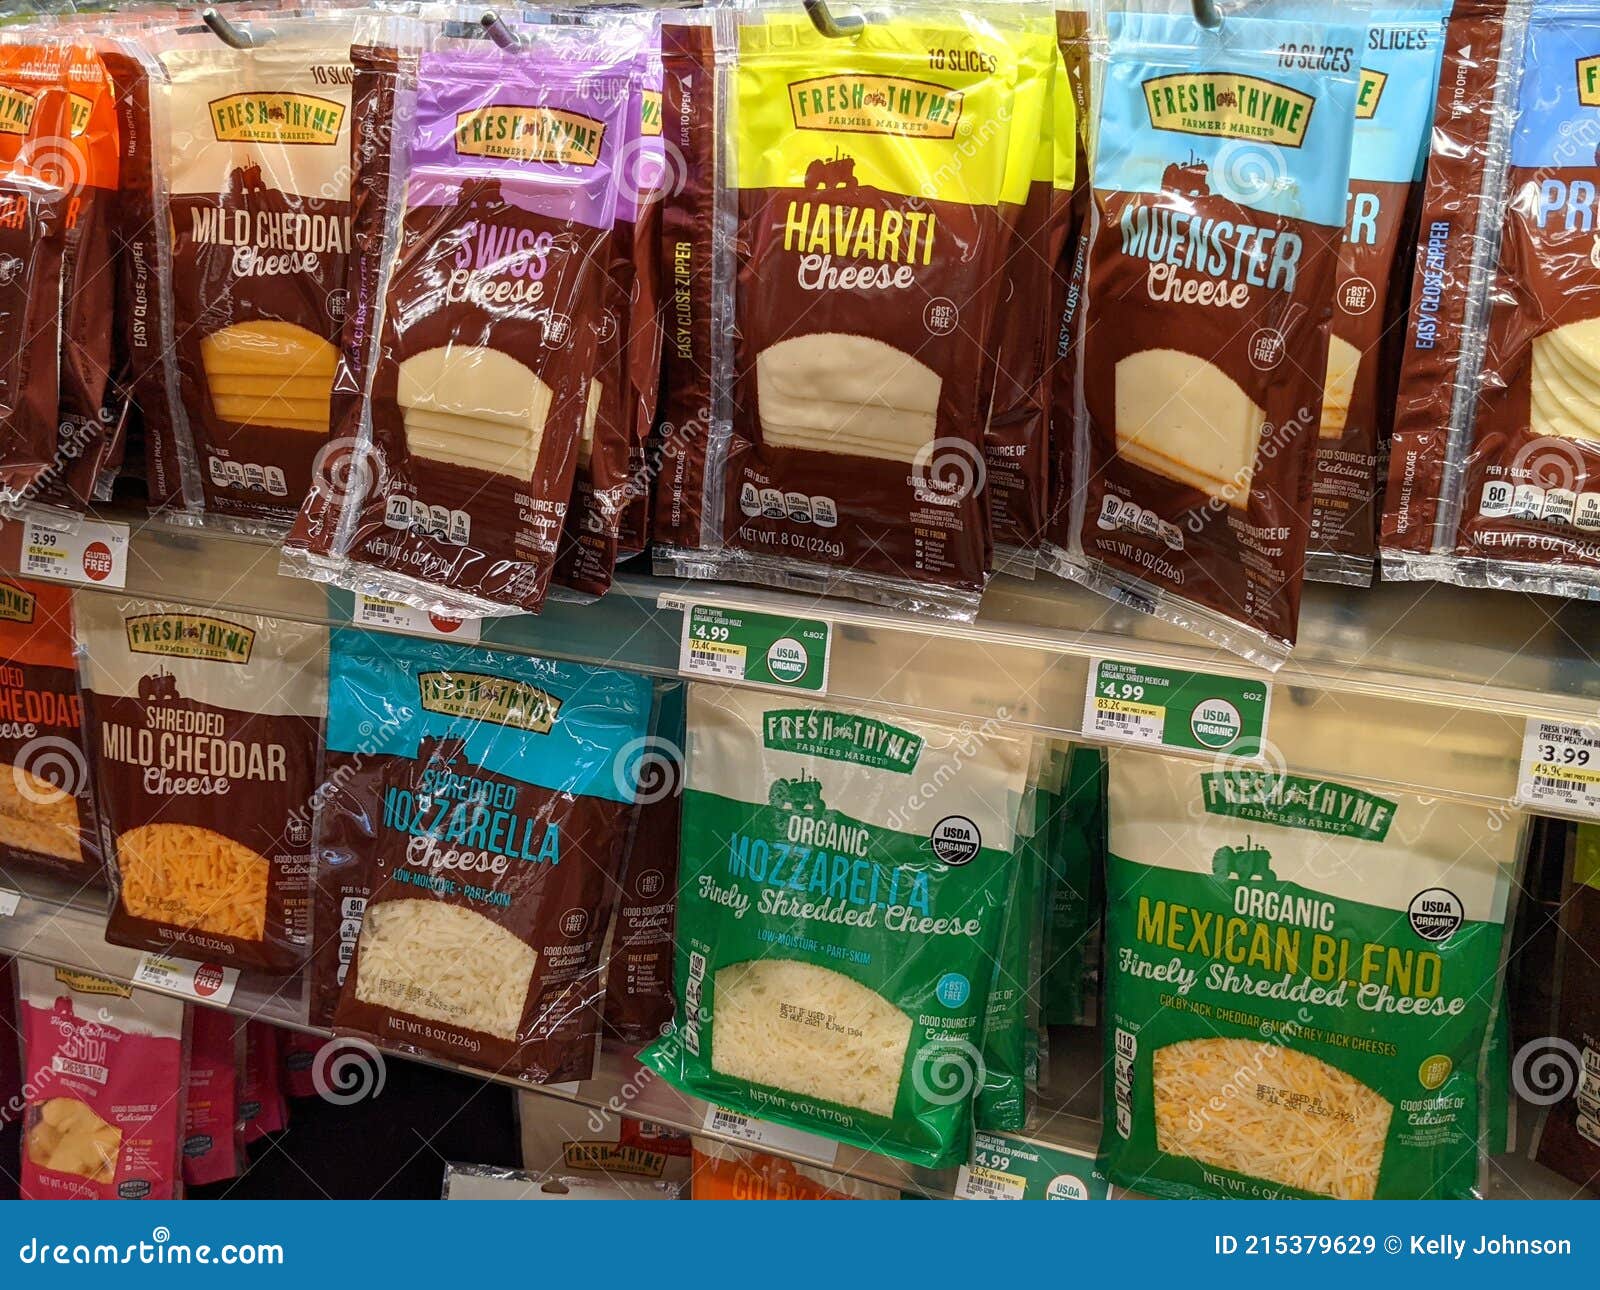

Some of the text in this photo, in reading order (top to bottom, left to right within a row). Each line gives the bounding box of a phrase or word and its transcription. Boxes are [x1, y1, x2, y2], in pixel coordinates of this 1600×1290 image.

[1368, 28, 1428, 50] SLICES
[928, 48, 997, 74] 10 SLICES
[1278, 43, 1354, 73] 10 SLICES
[310, 66, 326, 84] 10
[797, 85, 955, 126] FRESH THYME
[1152, 83, 1304, 134] FRESH THYME
[216, 100, 338, 134] FRESH THYME
[680, 90, 692, 147] TEAR OPEN
[828, 116, 872, 128] FARMERS
[1182, 118, 1226, 130] FARMERS
[460, 115, 598, 156] FRESH THYME
[485, 144, 527, 157] FARMERS
[191, 206, 350, 254] MILD CHEDDA
[783, 201, 936, 265] HAVARTI
[455, 221, 553, 281] SWISS
[1121, 203, 1303, 292] MUENSTER
[232, 245, 320, 277] Cheese
[797, 254, 915, 290] Cheese
[134, 241, 148, 348] EASY CLOSE ZIPPER
[448, 269, 544, 303] Cheese
[1147, 263, 1250, 308] Cheese
[1416, 222, 1449, 349] EASY CLOSE ZIPPER
[675, 242, 692, 358] EASY CLOSE ZIPPER
[1346, 296, 1366, 307] FREE
[930, 316, 949, 328] FREE
[1057, 283, 1081, 357] EASY CLOSE
[1254, 349, 1274, 362] FREE
[1334, 450, 1366, 464] SOURCE
[1317, 461, 1370, 479] Calcium
[1511, 468, 1532, 478] SLICE
[672, 450, 685, 527] RESEALABLE PACKAGE
[906, 476, 956, 493] GOOD SOURCE
[1397, 451, 1416, 534] RESEALABLE PACKAGE
[1489, 487, 1505, 501] 80
[393, 501, 407, 514] 70
[914, 490, 961, 508] Calcium
[1107, 501, 1118, 515] 80
[740, 526, 844, 557] NET 8 OZ (226g)
[1237, 532, 1284, 557] Calcium
[1278, 527, 1291, 540] OF
[1474, 531, 1560, 551] NET 8 OZ
[84, 559, 110, 572] FREE
[85, 551, 110, 560] GLUTEN
[1096, 539, 1184, 584] NET (226g)
[132, 623, 249, 656] FRESH THYME
[693, 624, 729, 641] $4.99
[777, 648, 799, 660] USDA
[772, 661, 801, 672] ORGANIC
[1102, 662, 1137, 674] FRESH THYME
[1101, 671, 1169, 687] ORGANIC MEXICAN
[1100, 681, 1144, 700] $4.99
[146, 706, 225, 737] SHREDDED
[1203, 709, 1231, 724] USDA
[1197, 724, 1233, 738] ORGANIC
[1540, 724, 1559, 734] FRESH
[1540, 732, 1562, 743] CHEESE
[102, 722, 287, 782] MILD CHEDDAR
[768, 717, 916, 765] FRESH THYME
[796, 742, 841, 758] FARMERS
[1538, 744, 1590, 766] $3.99
[143, 766, 230, 795] Cheese
[423, 769, 517, 811] SHREDDED
[1209, 779, 1387, 832] FRESH THYME
[1240, 807, 1293, 824] FARMERS
[787, 815, 869, 857] ORGANIC
[943, 827, 970, 841] USDA
[406, 835, 509, 874] Cheese
[938, 841, 973, 854] ORGANIC
[728, 832, 930, 916] MOZZARELLA
[698, 876, 981, 936] Finely Shredded Cheese
[1234, 886, 1335, 931] ORGANIC
[1422, 900, 1451, 914] USDA
[566, 923, 581, 931] FREE
[1416, 915, 1454, 928] ORGANIC
[757, 928, 871, 965] LOW-MOISTURE PART-SKIM
[1136, 897, 1442, 999] MEXICAN BLEND
[195, 976, 219, 988] FREE
[1119, 947, 1466, 1017] Finely Shredded Cheese
[944, 991, 961, 1000] FREE
[920, 1014, 940, 1027] GOOD
[1160, 994, 1397, 1056] COLBY CHEDDAR MONTEREY JACK CHEESES
[389, 1017, 481, 1052] NET 8 OZ (226g)
[925, 1028, 969, 1041] Calcium
[800, 1102, 854, 1128] OZ (170g)
[1408, 1112, 1457, 1125] Calcium
[1057, 1184, 1080, 1198] USDA
[1204, 1171, 1259, 1195] NET 6
